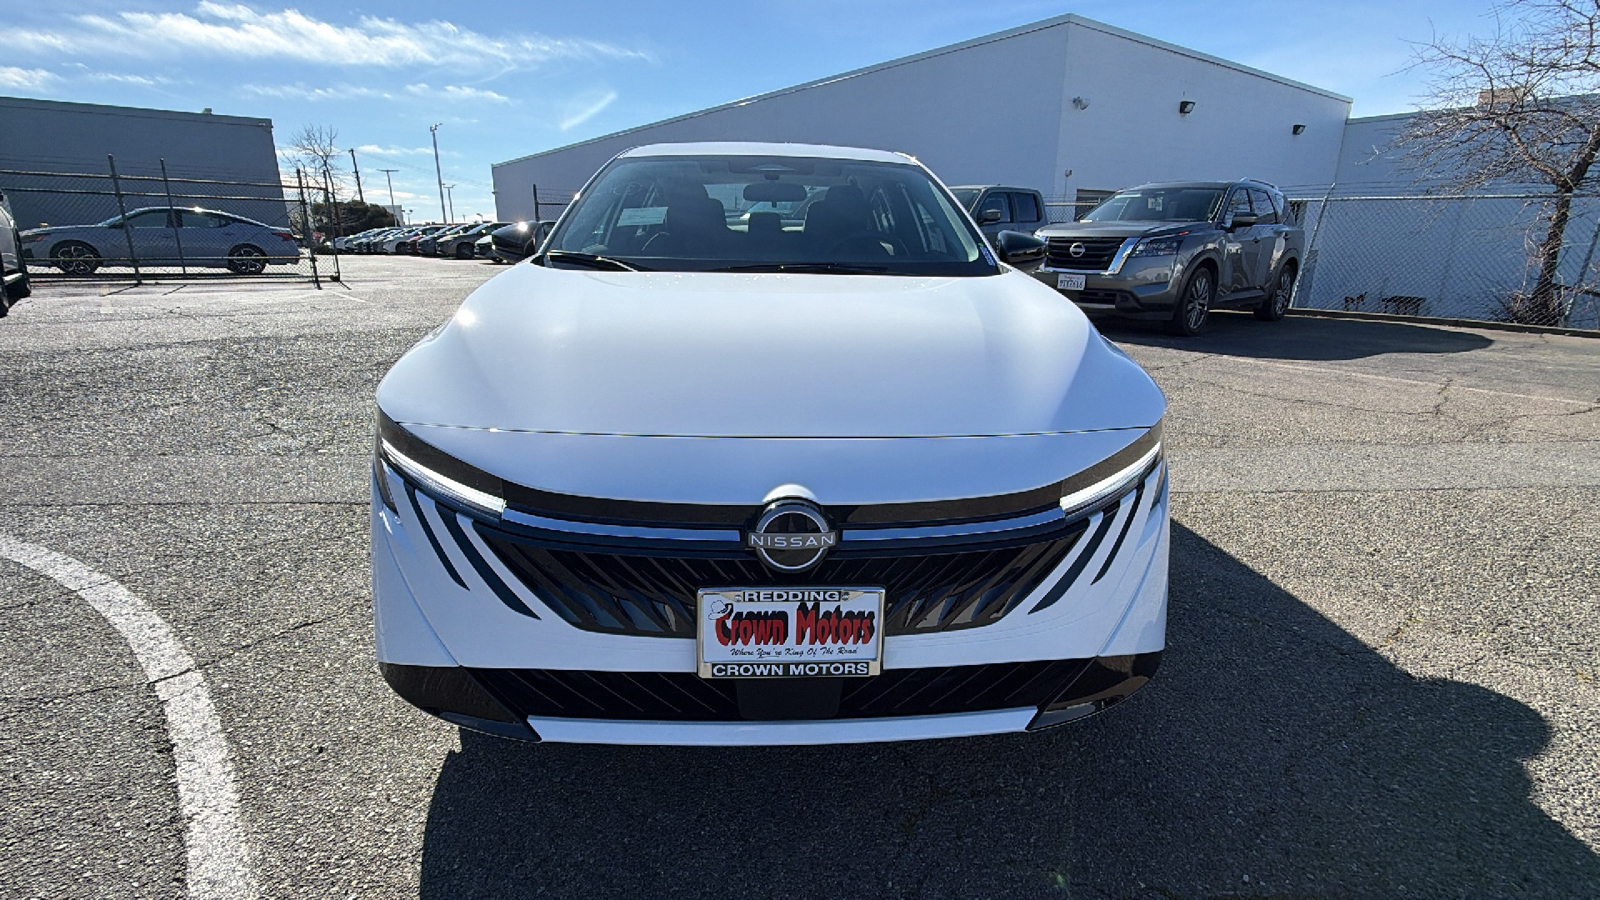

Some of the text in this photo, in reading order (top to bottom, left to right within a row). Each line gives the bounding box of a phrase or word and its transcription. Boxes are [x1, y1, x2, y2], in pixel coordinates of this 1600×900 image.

[751, 534, 834, 547] NISSAN
[744, 590, 840, 602] REDDING
[715, 602, 875, 646] Crown Motors
[730, 647, 858, 659] Where You're King Of The Road
[712, 663, 868, 677] CROWN MOTORS
